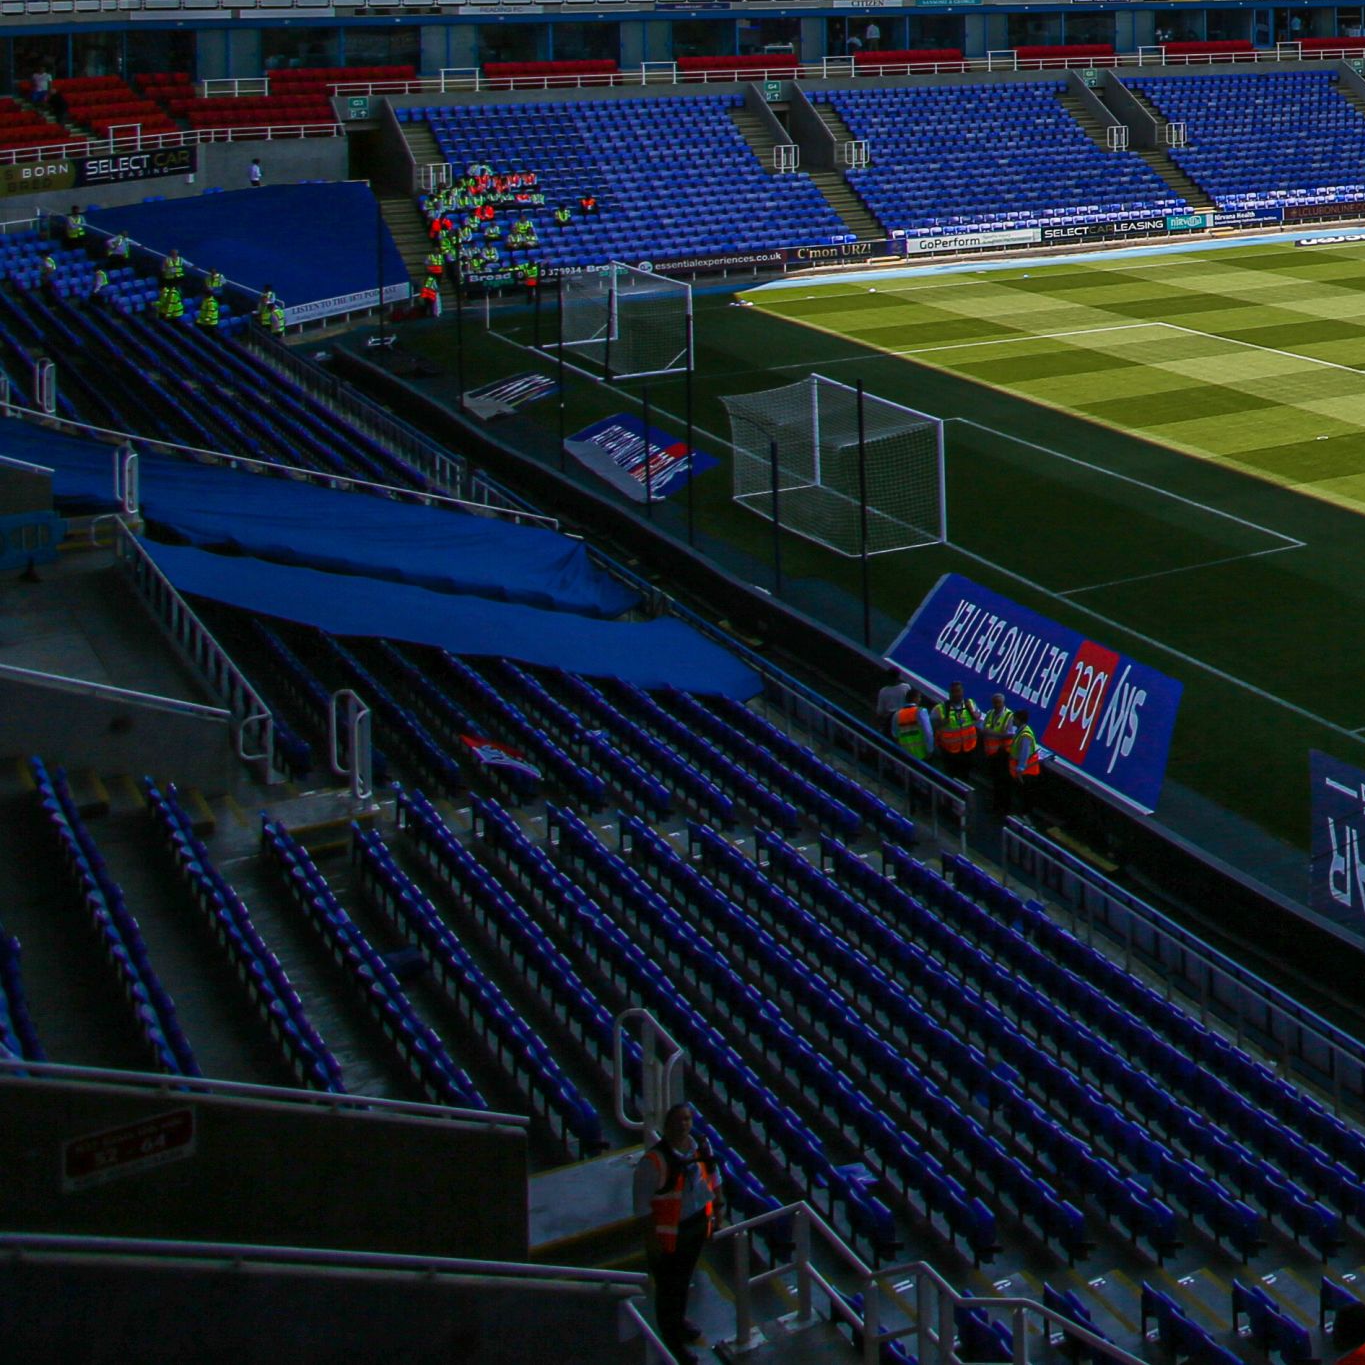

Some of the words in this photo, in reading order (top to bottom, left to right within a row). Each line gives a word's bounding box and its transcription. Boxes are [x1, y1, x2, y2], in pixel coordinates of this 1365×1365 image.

[22, 163, 69, 179] BORN
[86, 154, 151, 176] SELECT
[154, 150, 190, 167] CAR
[110, 167, 170, 180] LEASING
[797, 244, 838, 259] C'mon
[841, 243, 872, 256] URZ!
[919, 236, 981, 250] GoPerform
[655, 251, 782, 270] essentialexperiences.co.uk
[469, 271, 511, 282] Broad
[292, 303, 319, 315] LISTEN
[321, 300, 332, 308] TO
[332, 297, 347, 305] THE
[364, 286, 397, 299] PODAST
[935, 599, 1007, 673] BETTER
[988, 626, 1069, 709] BETTING
[1058, 661, 1108, 751] bet
[1096, 664, 1147, 774] sky
